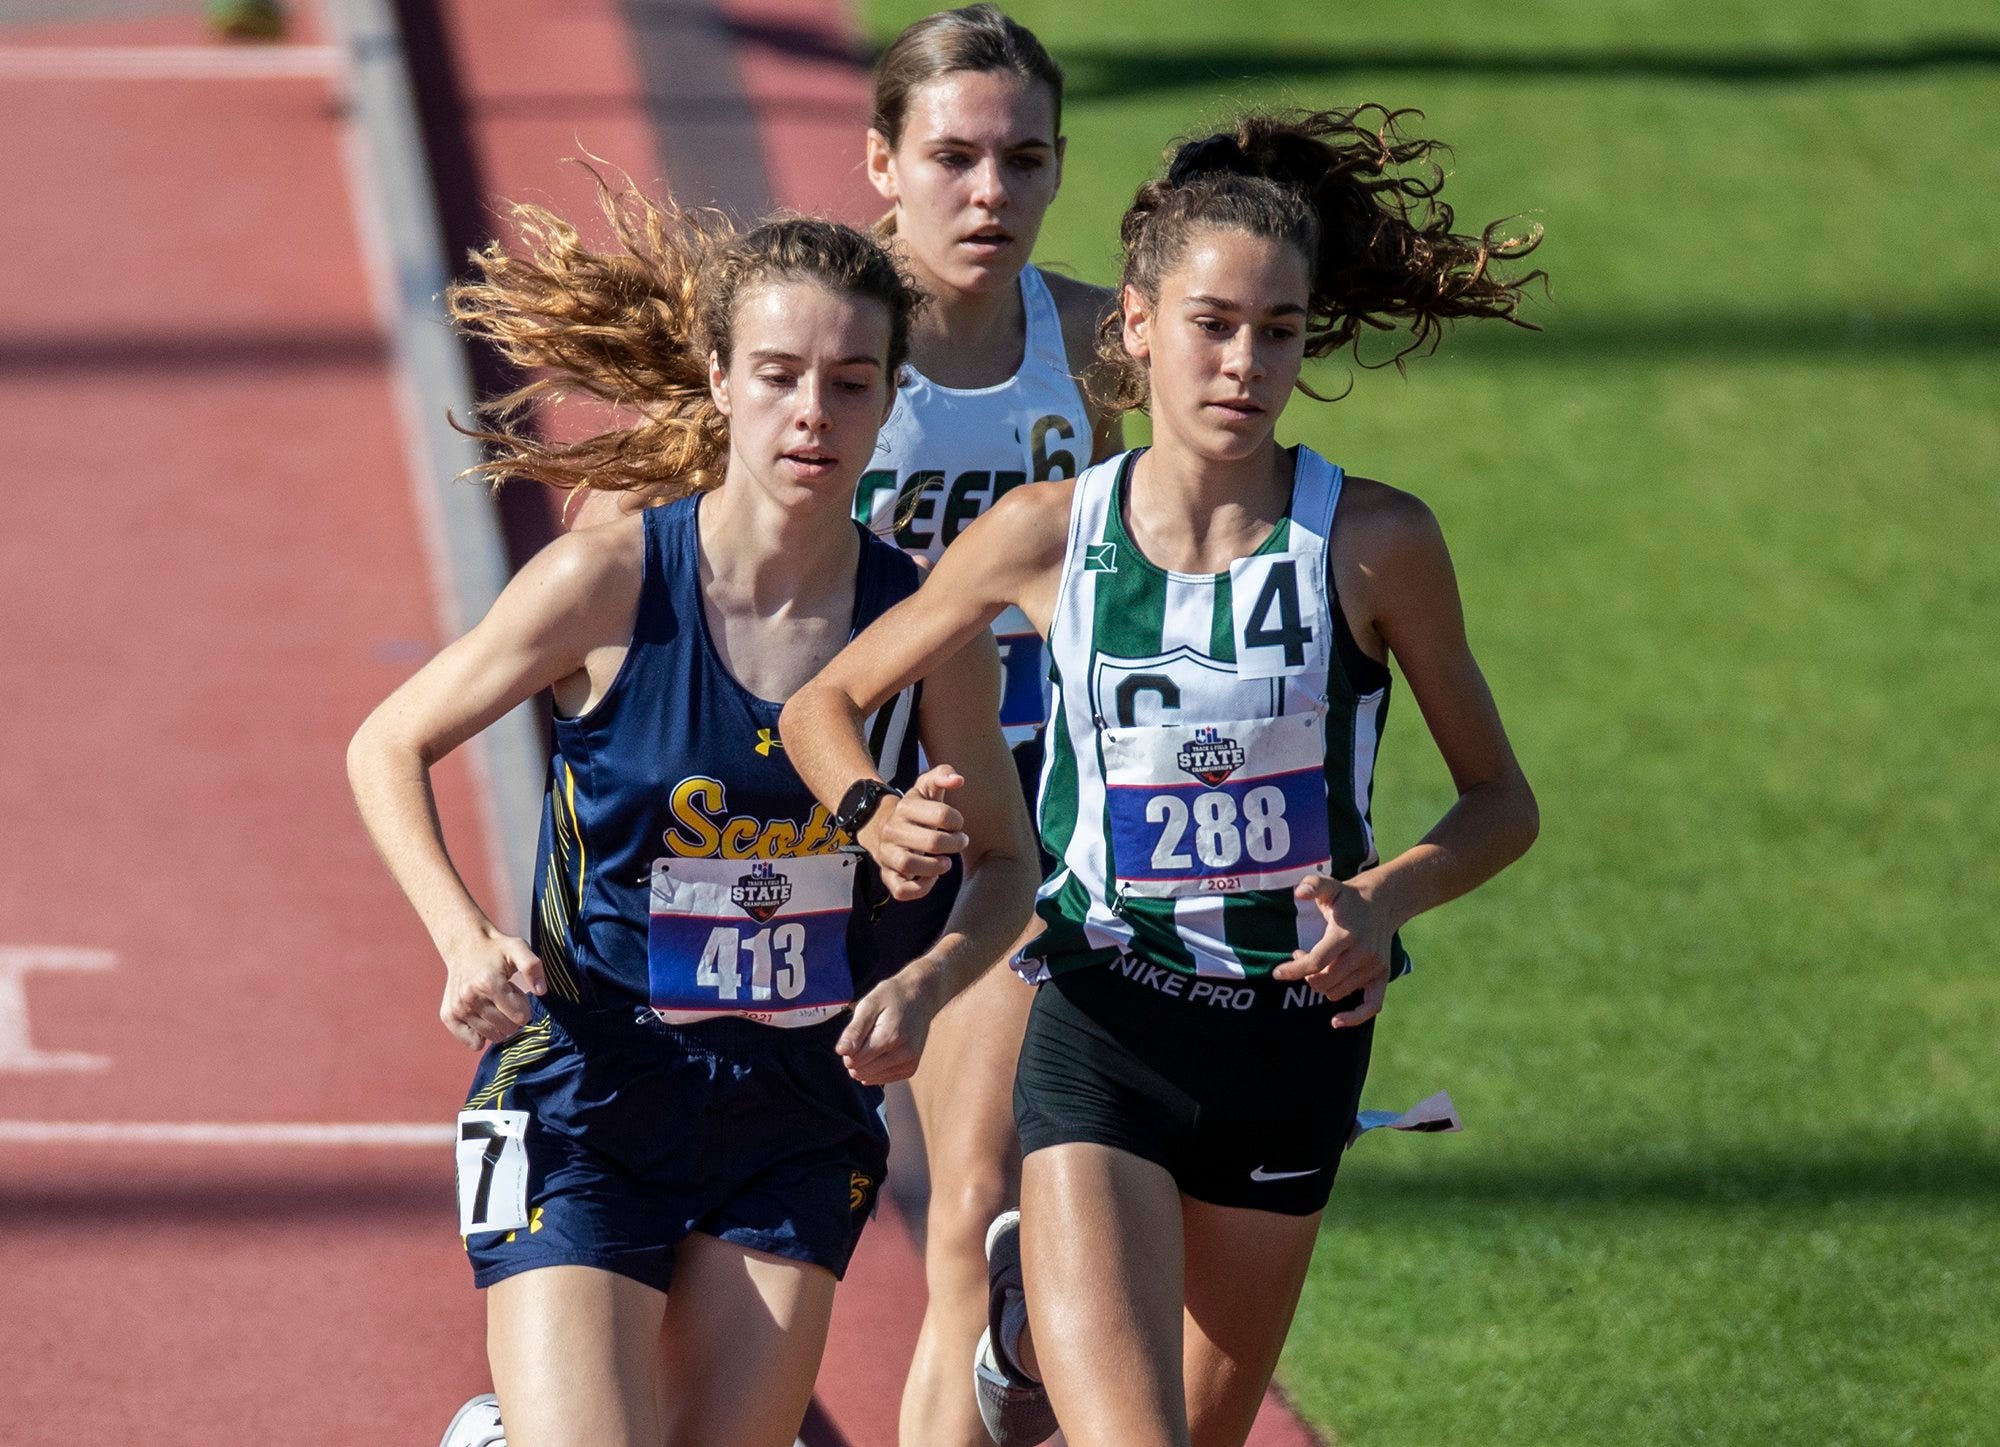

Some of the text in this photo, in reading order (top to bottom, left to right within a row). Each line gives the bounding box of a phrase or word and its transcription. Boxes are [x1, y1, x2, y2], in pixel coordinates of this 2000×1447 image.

[1244, 560, 1313, 667] 4
[1178, 749, 1244, 768] STATE
[1146, 785, 1291, 870] 288
[732, 885, 791, 901] STATE
[1207, 877, 1242, 891] 2021
[696, 922, 806, 1000] 413
[1109, 956, 1256, 1010] NIKE PRO
[740, 1011, 773, 1023] 2021
[461, 1119, 513, 1225] 7
